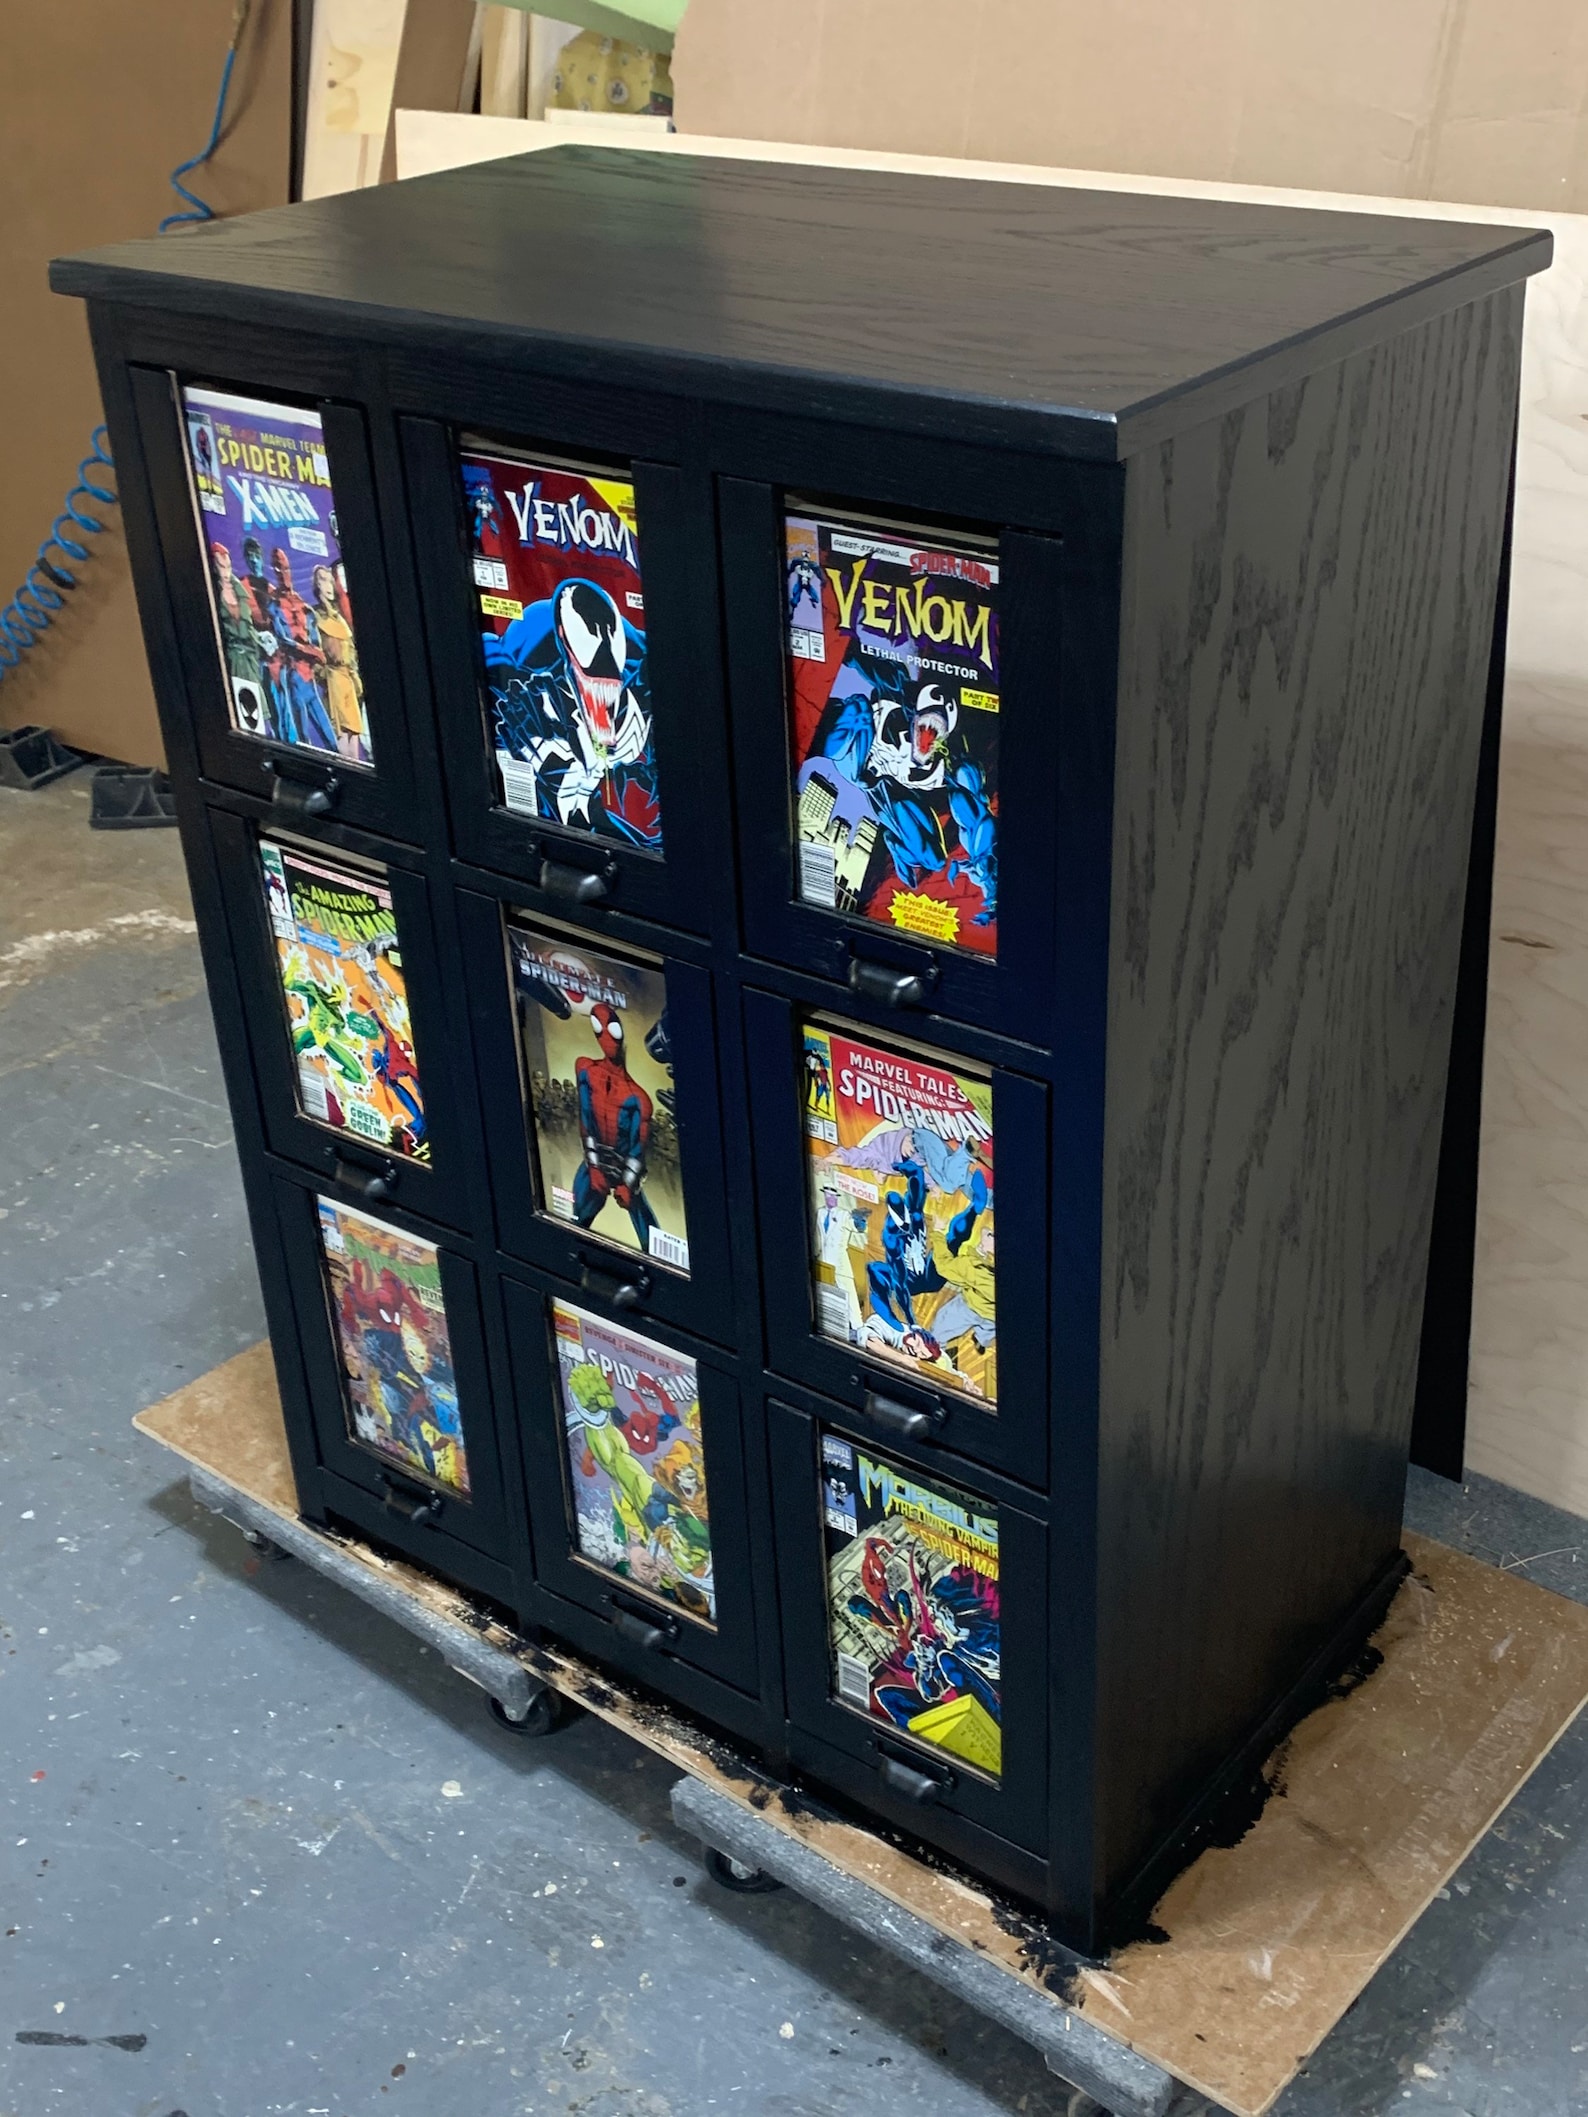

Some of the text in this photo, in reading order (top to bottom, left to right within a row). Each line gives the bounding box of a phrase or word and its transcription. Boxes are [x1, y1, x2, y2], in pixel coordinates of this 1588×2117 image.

[215, 422, 233, 437] THE
[260, 432, 298, 451] MARVEL
[225, 475, 320, 530] X-MEN
[503, 480, 639, 570] VENOM
[909, 551, 991, 591] SPIDER-MAN
[825, 558, 994, 671] VENOM
[860, 644, 978, 681] LETHAL PROTECTOR
[963, 691, 984, 701] PART
[290, 891, 397, 943] SPIDER-MAN
[310, 884, 377, 912] AMAZING
[895, 904, 918, 914] MEET
[904, 898, 923, 909] THIS
[903, 913, 945, 929] GREATEST
[519, 959, 627, 1009] SPIDER-MAN
[521, 942, 616, 988] ULTIMATE
[849, 1051, 913, 1085] MARVEL
[916, 1072, 968, 1103] TALES
[350, 1106, 381, 1127] GREEN
[838, 1068, 993, 1143] SPIDER-MAN
[856, 1453, 998, 1543] MORBIUS
[895, 1498, 917, 1519] THE
[918, 1506, 954, 1537] LIVING
